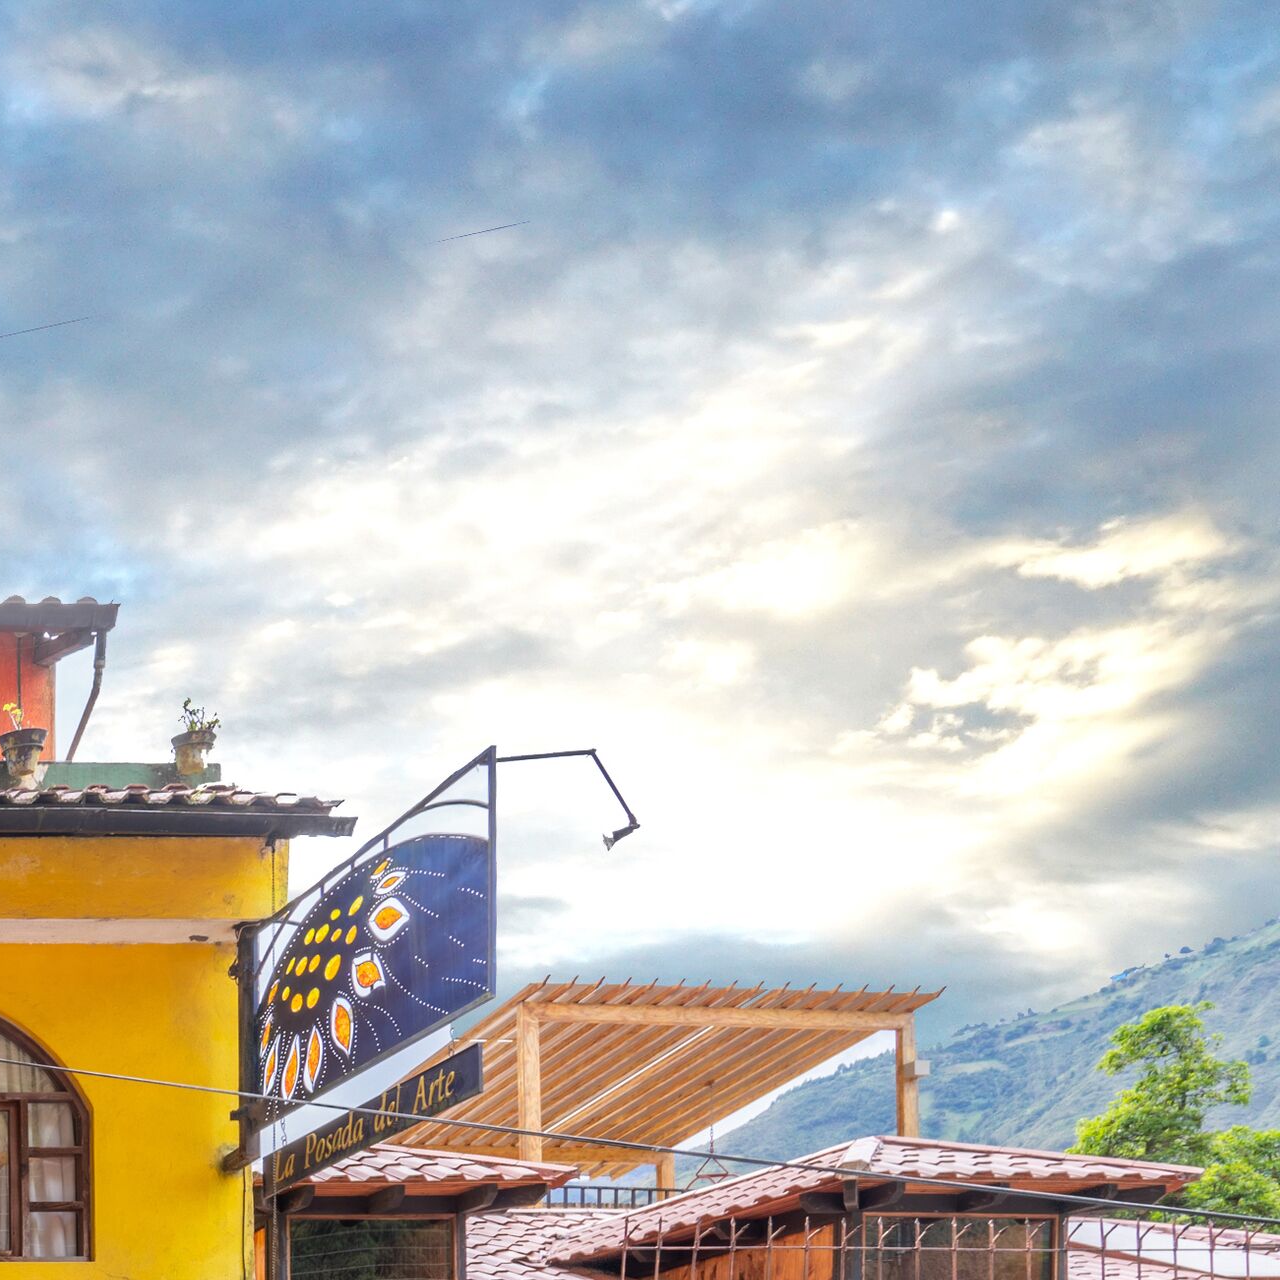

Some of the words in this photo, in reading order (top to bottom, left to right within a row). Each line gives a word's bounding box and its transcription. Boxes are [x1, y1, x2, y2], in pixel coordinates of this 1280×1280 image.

[275, 1151, 295, 1183] La
[304, 1111, 364, 1170] Posada
[374, 1083, 401, 1134] del
[412, 1069, 456, 1115] Arte
